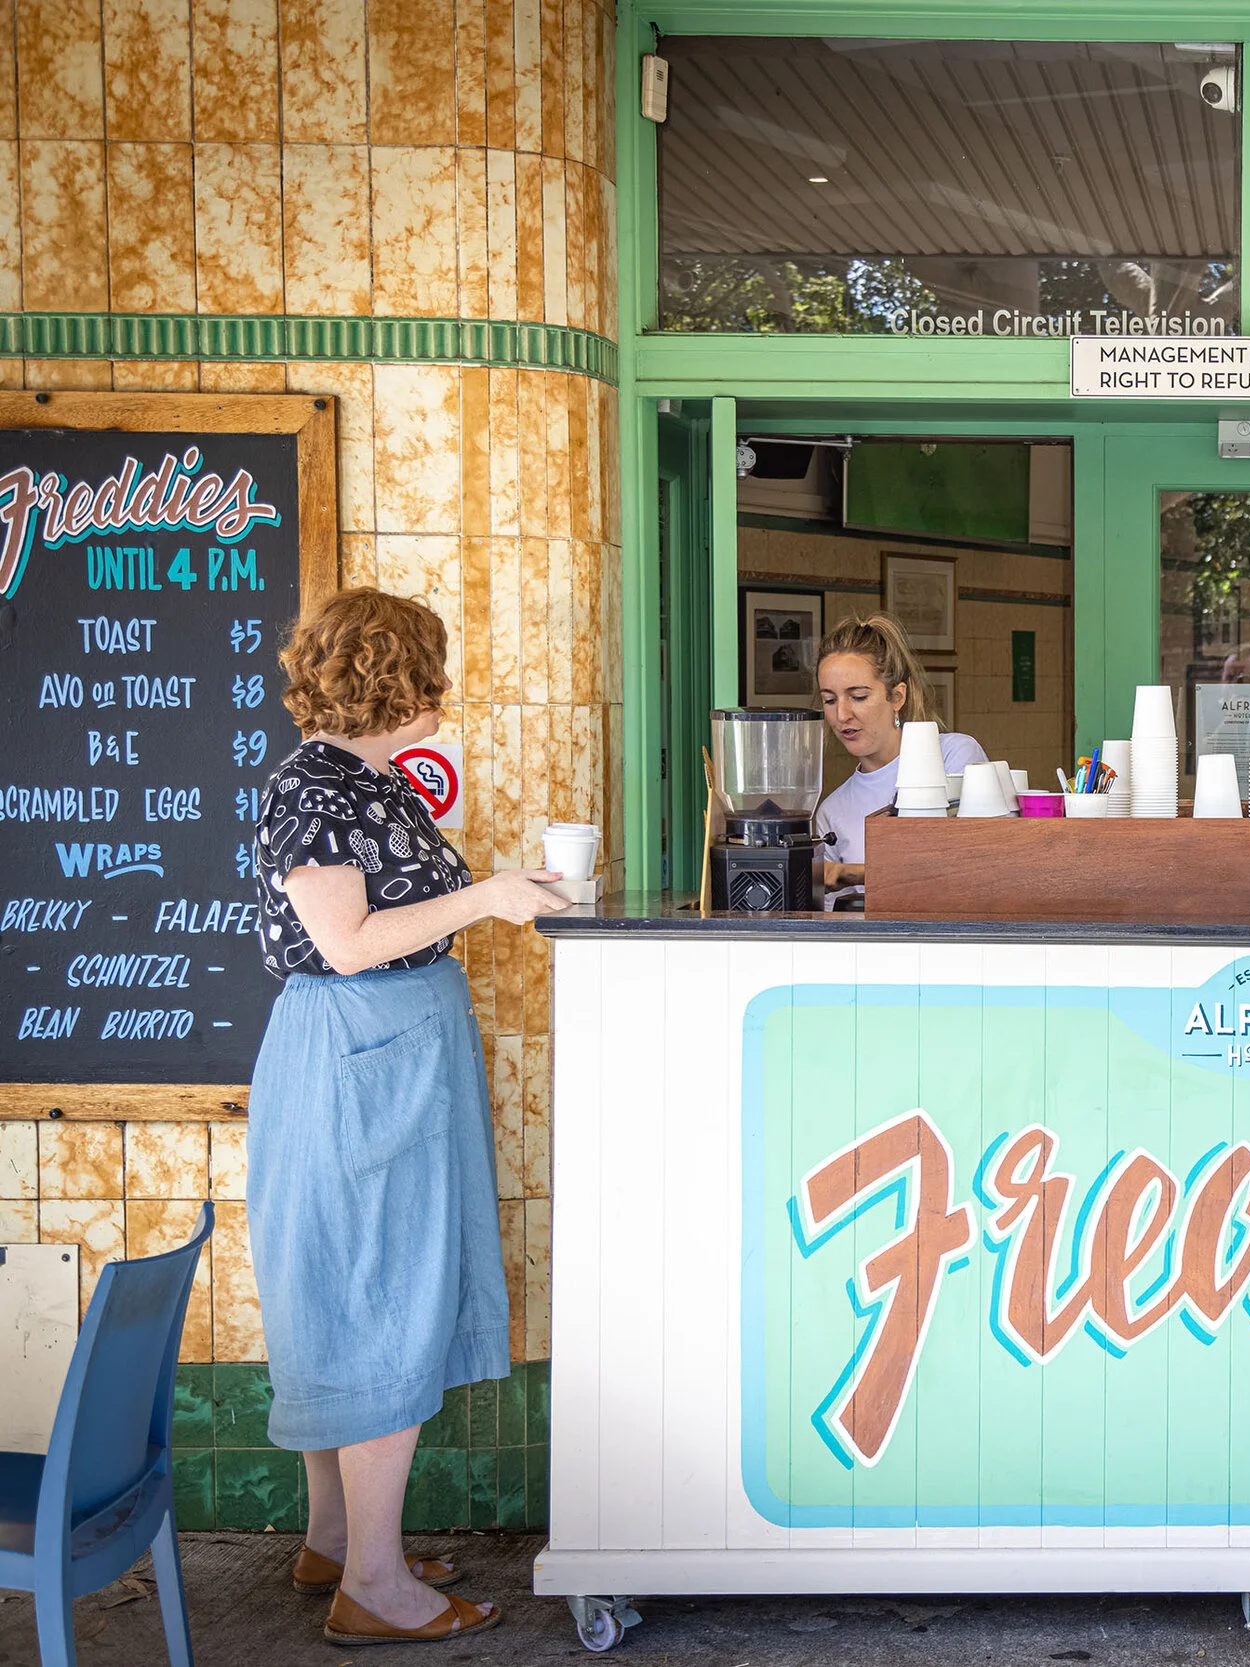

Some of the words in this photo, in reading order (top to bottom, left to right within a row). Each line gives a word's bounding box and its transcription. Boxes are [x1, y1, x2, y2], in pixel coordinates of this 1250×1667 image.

[890, 309, 984, 336] Closed
[992, 309, 1082, 336] Circuit
[1090, 310, 1226, 336] Television
[1100, 346, 1249, 364] MANAGEMENT
[1100, 371, 1162, 389] RIGHT
[1167, 372, 1196, 389] TO
[87, 546, 163, 591] UNTIL
[166, 547, 197, 591] 4
[207, 547, 265, 591] P.M.
[78, 616, 158, 654] TOAST
[230, 619, 263, 654] $5
[39, 673, 85, 709] AVO
[92, 682, 116, 709] on
[121, 674, 197, 709] TOAST
[232, 674, 266, 709] $8
[232, 730, 268, 767] $9
[145, 787, 202, 822] EGGS
[55, 843, 164, 879] WRAPS
[1, 898, 92, 932] BREKKY
[67, 953, 192, 989] SCHNITZEL
[18, 1006, 81, 1041] BEAN
[101, 1007, 194, 1041] BURRITO
